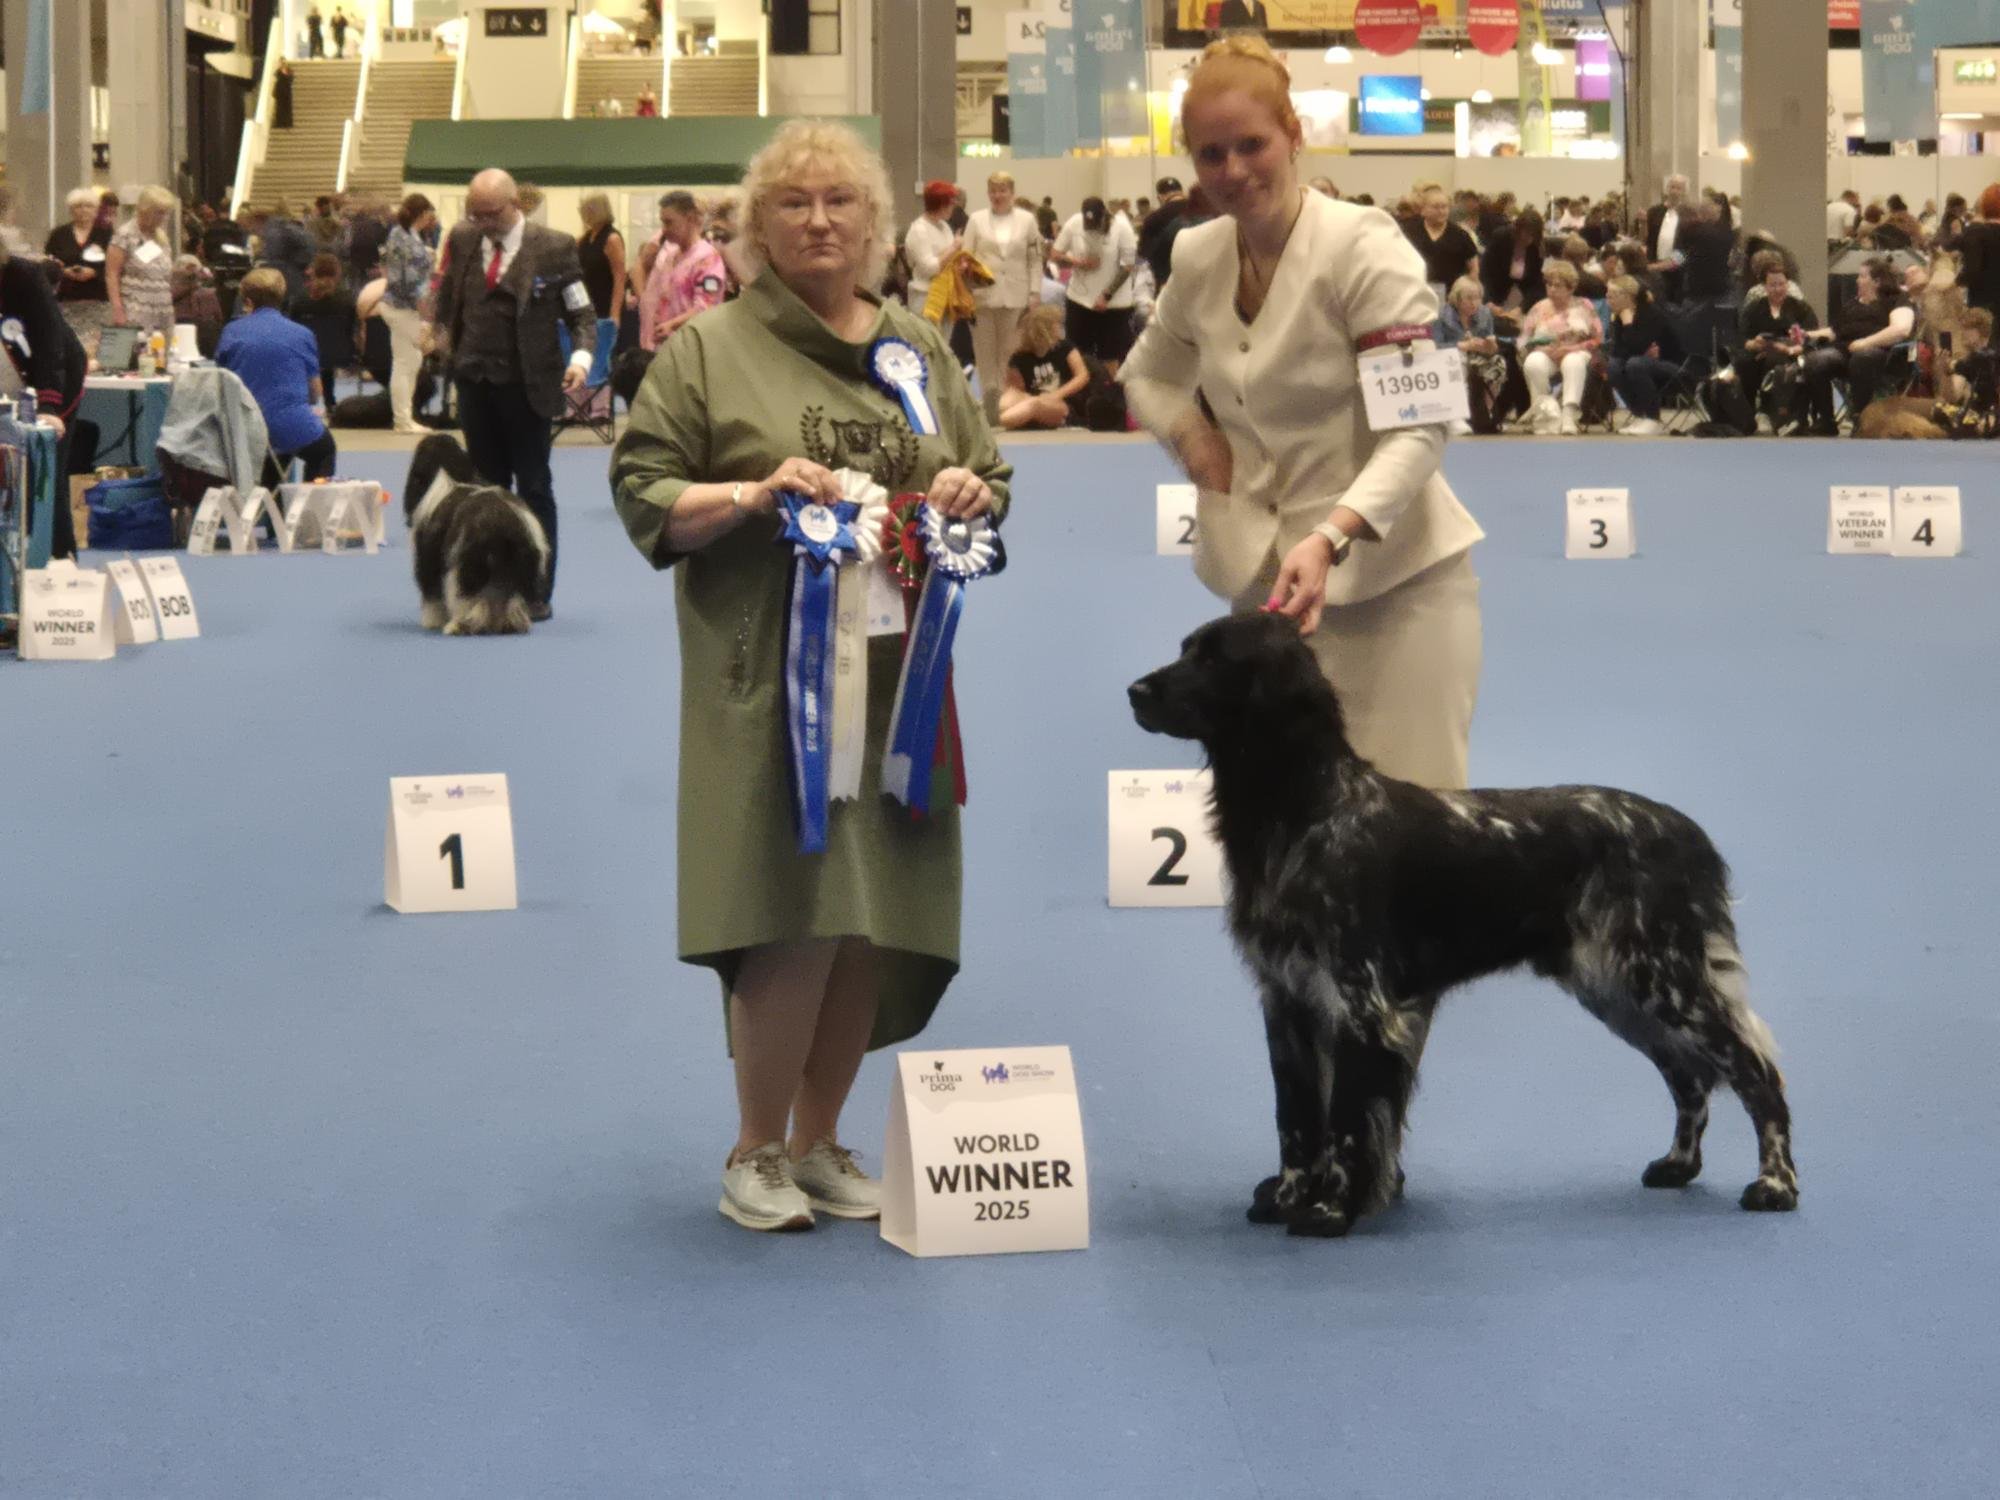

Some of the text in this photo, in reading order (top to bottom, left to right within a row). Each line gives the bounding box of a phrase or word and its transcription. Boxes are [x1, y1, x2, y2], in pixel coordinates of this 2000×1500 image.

[1375, 371, 1440, 396] 13969
[1176, 514, 1197, 545] 2
[1589, 518, 1608, 549] 3
[1837, 518, 1886, 528] VETERAN
[1839, 529, 1884, 539] WINNER
[1911, 518, 1934, 547] 4
[48, 608, 84, 618] WORLD
[128, 598, 150, 621] BOS
[159, 595, 191, 618] BOB
[33, 620, 95, 634] WINNER
[51, 636, 76, 646] 2025
[439, 832, 465, 890] 1
[1146, 826, 1190, 886] 2
[919, 1070, 963, 1084] Prima
[930, 1082, 956, 1092] DOG
[953, 1132, 1041, 1155] WORLD
[925, 1159, 1074, 1195] WINNER
[973, 1200, 1031, 1222] 2025
